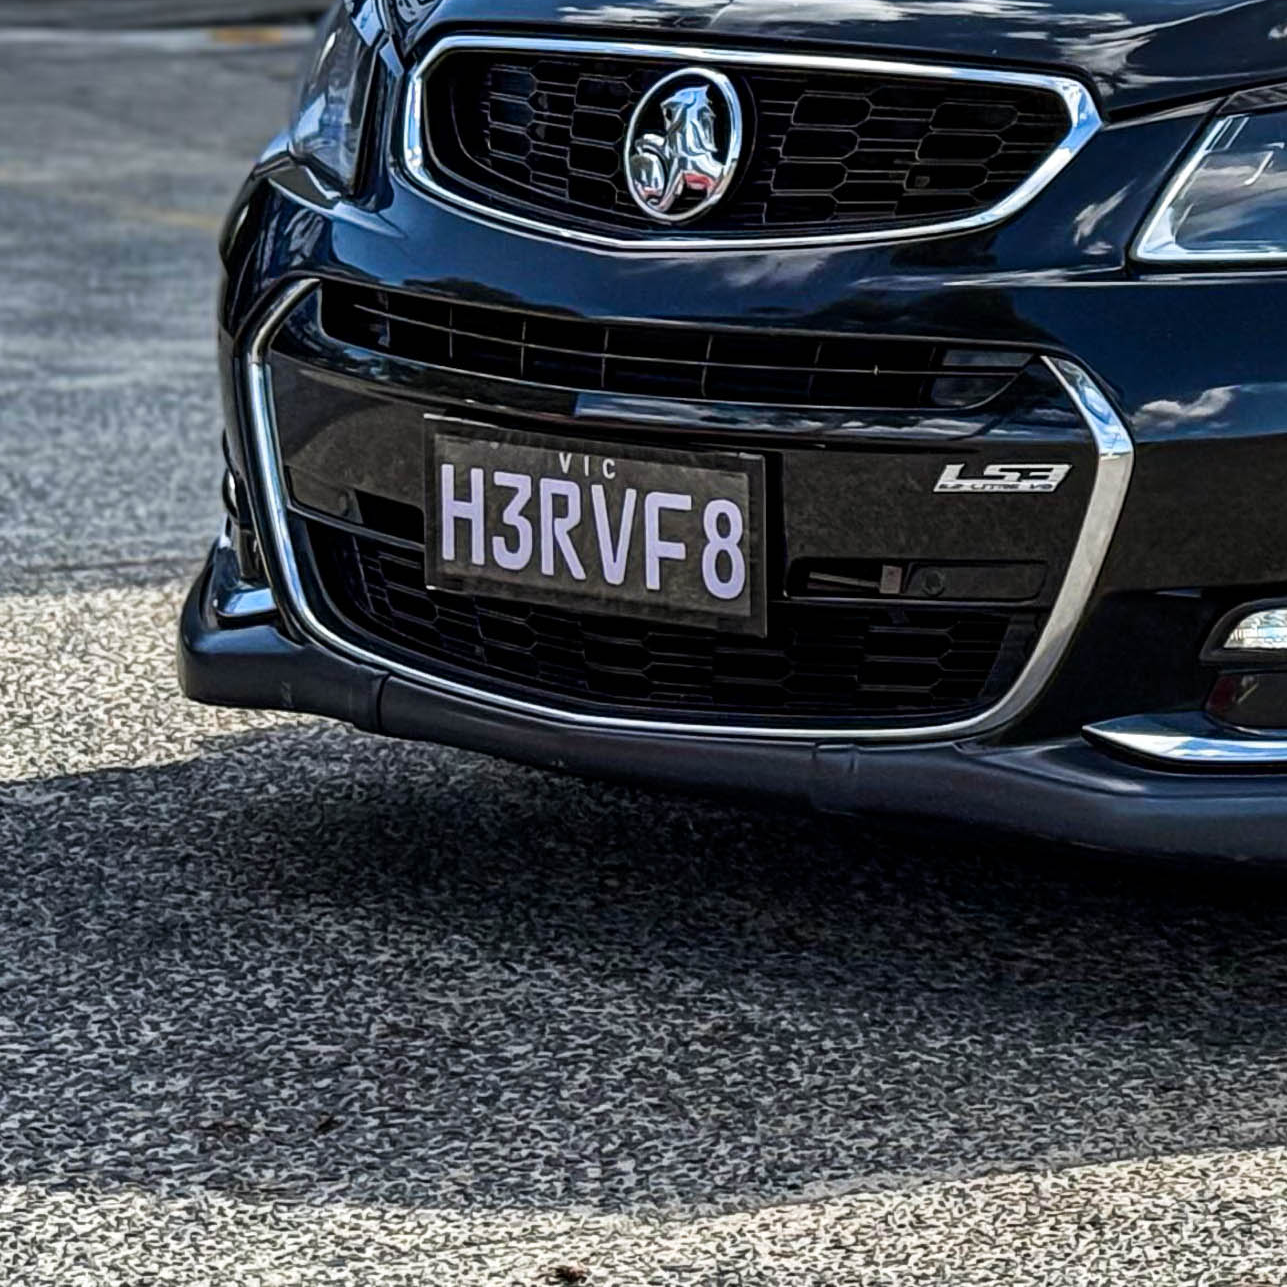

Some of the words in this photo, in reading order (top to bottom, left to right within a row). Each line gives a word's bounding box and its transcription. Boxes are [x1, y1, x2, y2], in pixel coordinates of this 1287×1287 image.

[558, 451, 616, 480] VIC
[938, 463, 1072, 483] LS3
[440, 463, 748, 601] H3RVF8
